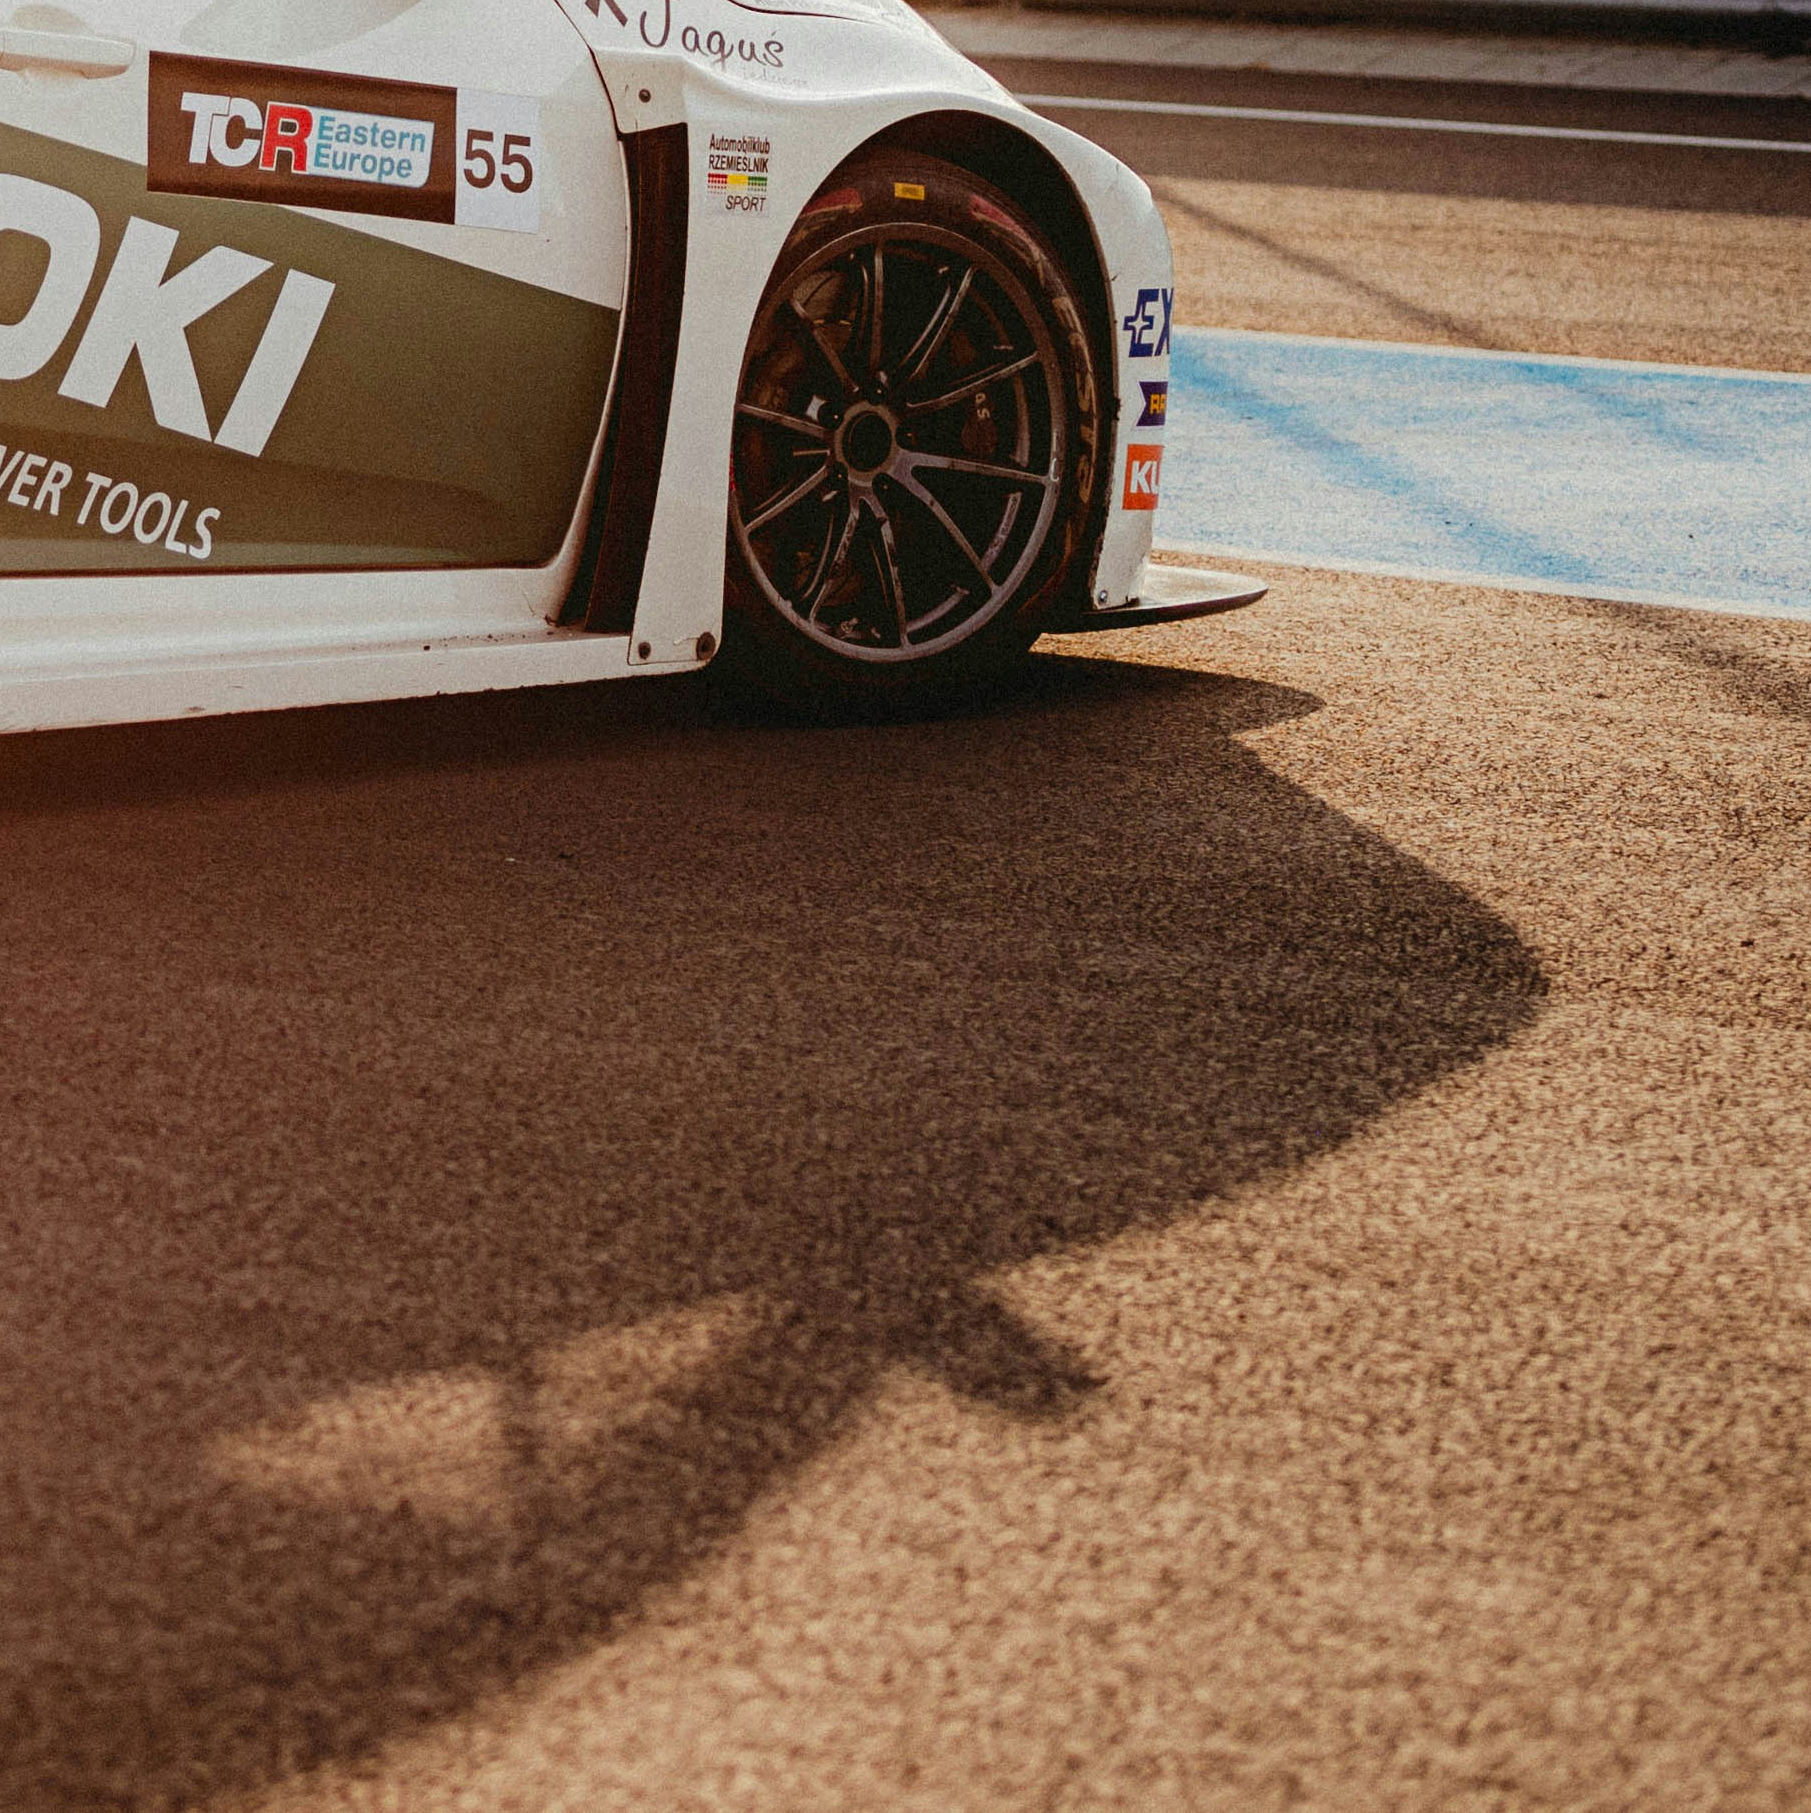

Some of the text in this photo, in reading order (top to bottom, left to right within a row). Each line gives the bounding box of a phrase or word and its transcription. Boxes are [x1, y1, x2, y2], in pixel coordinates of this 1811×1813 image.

[180, 91, 313, 175] TCR
[317, 114, 427, 153] Eastern
[709, 133, 771, 155] Automobilklub
[313, 143, 413, 182] Europe
[464, 129, 533, 194] 55
[726, 194, 767, 212] SPORT
[75, 472, 222, 561] TOOLS
